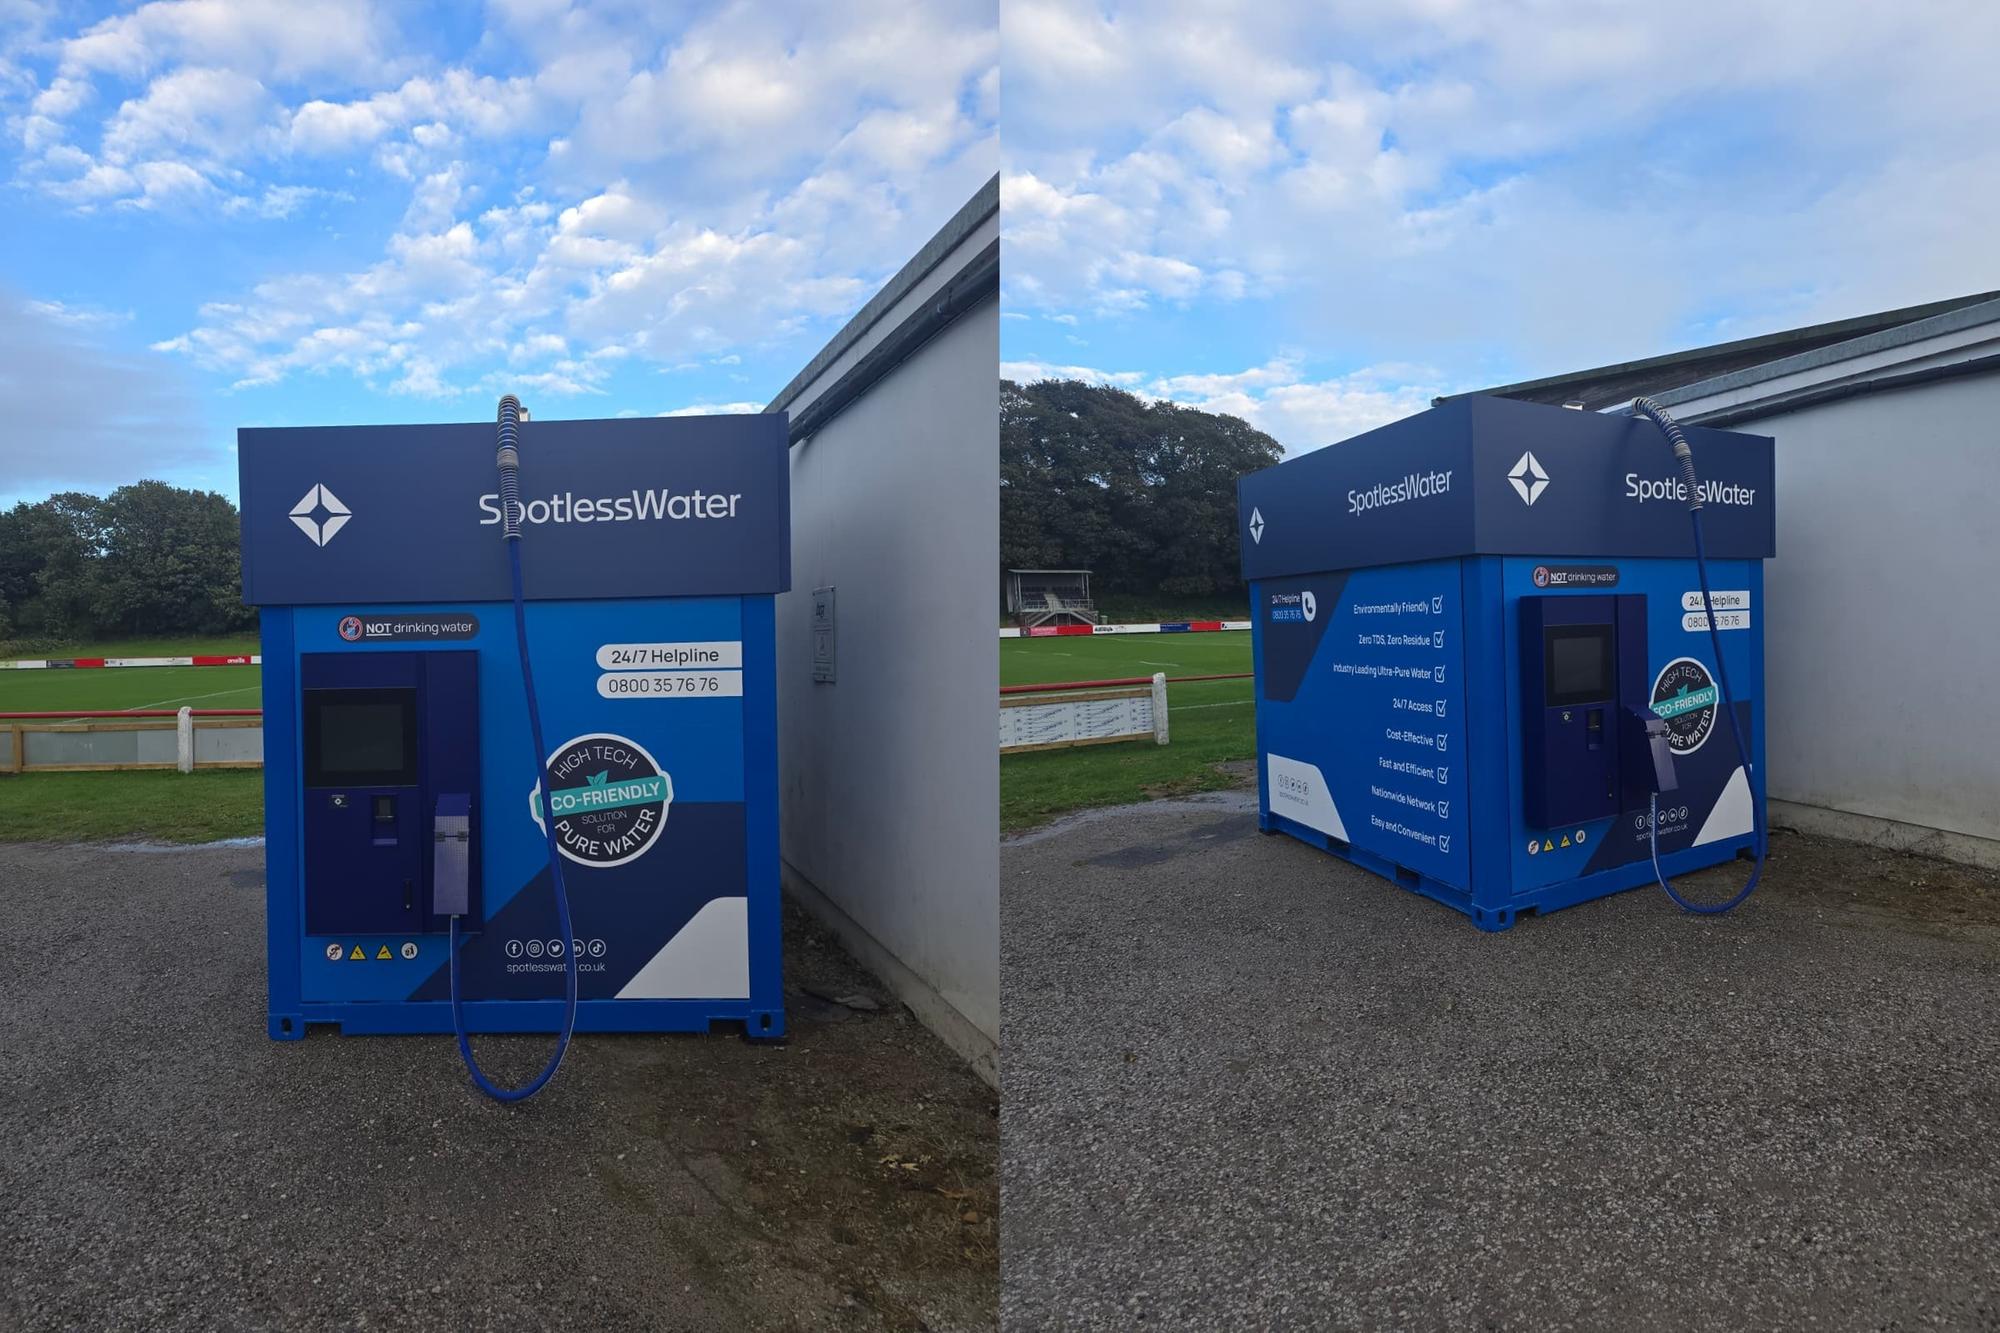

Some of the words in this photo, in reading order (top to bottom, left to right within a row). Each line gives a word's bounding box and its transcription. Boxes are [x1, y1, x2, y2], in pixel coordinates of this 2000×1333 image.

[1347, 470, 1452, 517] SpotlessWater
[1625, 473, 1755, 506] SpotlesWater
[1550, 572, 1567, 581] NOT
[1568, 572, 1595, 584] drinking
[1597, 573, 1616, 582] water
[1353, 602, 1401, 615] Environmentally
[1402, 600, 1429, 615] Friendly
[366, 623, 392, 634] NOT
[393, 622, 439, 635] drinking
[441, 622, 473, 633] water
[1720, 615, 1730, 626] 76
[1730, 615, 1740, 626] 76
[1358, 634, 1373, 645] Zero
[1387, 634, 1403, 645] Zero
[1403, 634, 1431, 646] Residue
[611, 649, 648, 664] 24/7
[651, 648, 719, 666] Helpline
[1333, 663, 1355, 676] Industry
[1354, 664, 1377, 678] Leading
[1377, 665, 1411, 678] Ultra-Pure
[1410, 667, 1432, 679] Water
[1660, 668, 1679, 692] HIGH
[1680, 666, 1703, 682] TECH
[608, 678, 649, 693] 0800
[653, 678, 673, 692] 35
[676, 677, 695, 692] 76
[699, 677, 719, 691] 76
[1392, 697, 1408, 709] 24/7
[1408, 700, 1433, 713] Access
[1685, 709, 1711, 745] WATER
[1386, 728, 1434, 746] Cost-Effective
[554, 748, 591, 780] HIGH
[593, 746, 638, 770] TECH
[1379, 757, 1393, 769] Fast
[1393, 762, 1406, 772] and
[1406, 763, 1435, 779] Efficient
[551, 781, 660, 812] CO-FRIENDLY
[1371, 785, 1406, 804] Nationwide
[1406, 794, 1436, 812] Network
[581, 810, 628, 825] SOLUTION
[555, 819, 600, 856] PURE
[603, 808, 656, 856] WATER
[597, 824, 616, 834] FOR
[1371, 815, 1386, 831] Easy
[1385, 821, 1397, 833] and
[1397, 824, 1436, 846] Convenient
[507, 962, 606, 975] spotlesswat.co.uk
